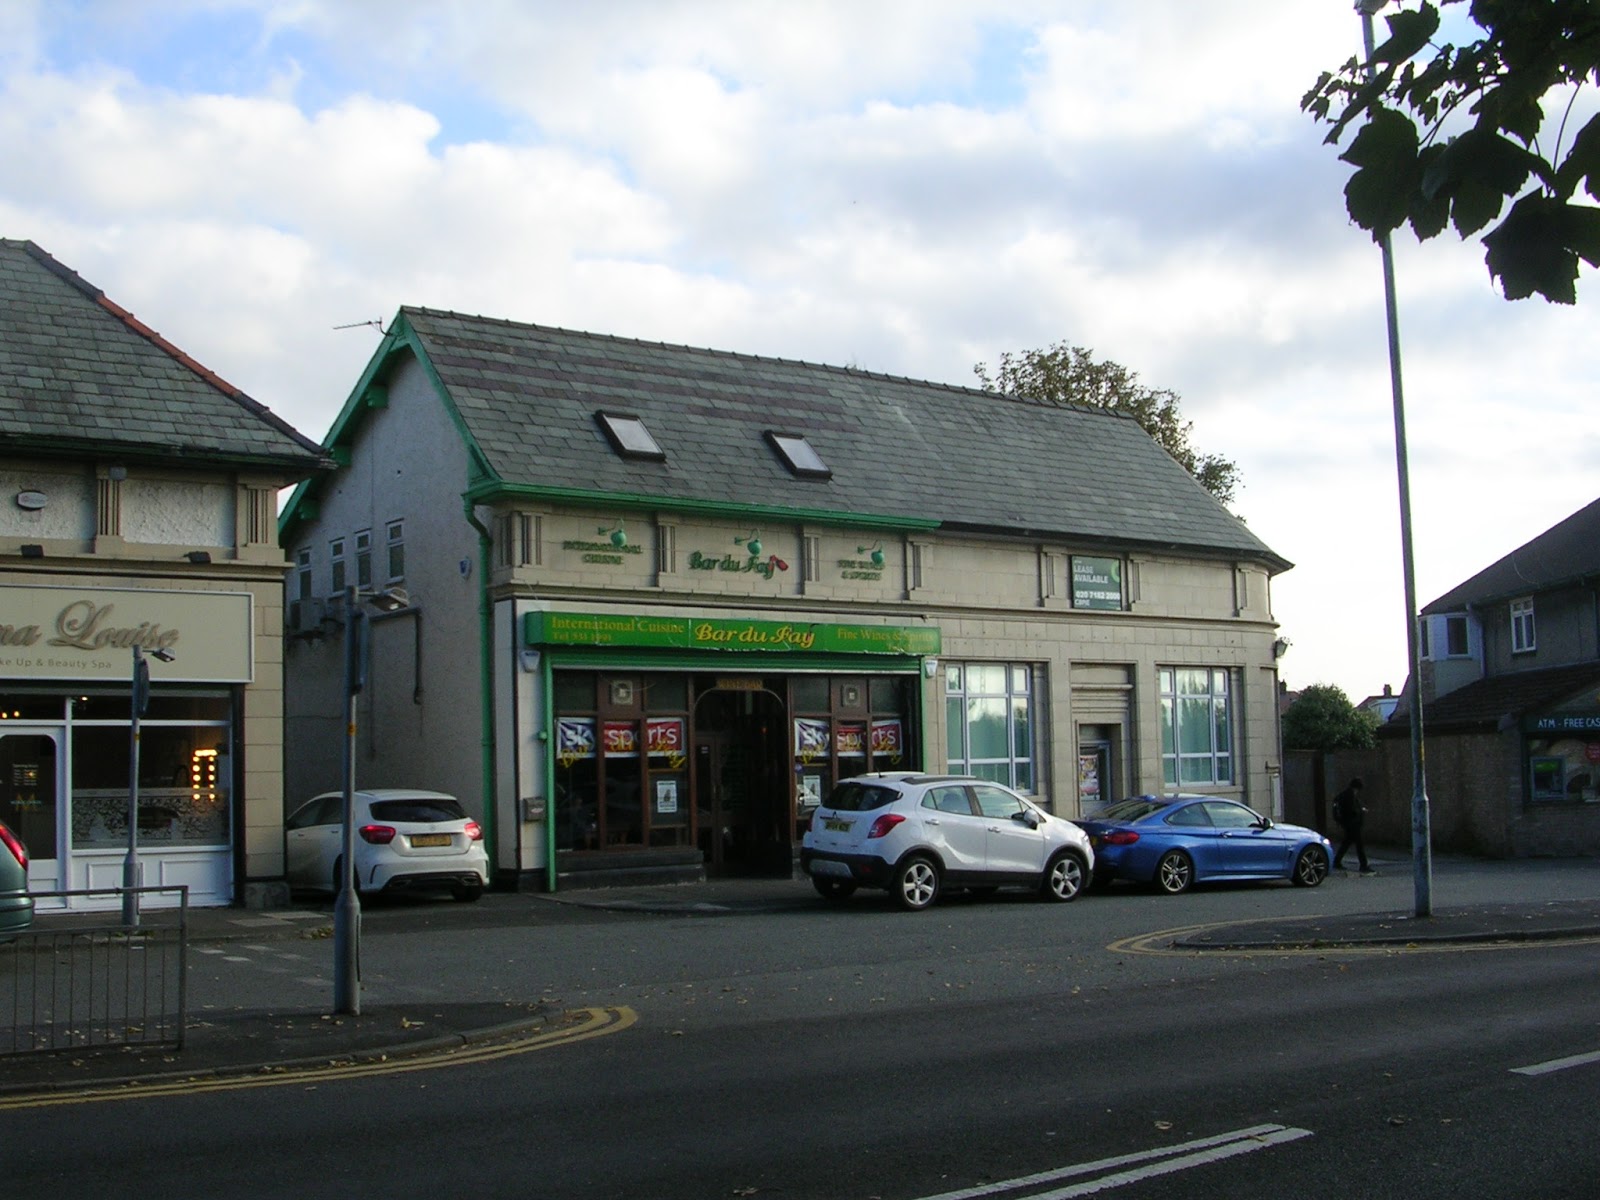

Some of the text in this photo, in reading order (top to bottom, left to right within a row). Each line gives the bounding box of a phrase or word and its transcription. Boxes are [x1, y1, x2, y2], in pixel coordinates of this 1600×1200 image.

[688, 550, 775, 580] Bar du Fay
[1073, 565, 1094, 574] LEASE
[1074, 574, 1109, 584] AVAILABLE
[48, 599, 179, 650] Louise
[551, 616, 684, 634] International Cuisine
[694, 622, 815, 649] Bar du Fay
[837, 627, 857, 640] Fine
[16, 657, 32, 667] Up
[36, 658, 44, 666] &
[48, 658, 87, 669] Beauty
[92, 660, 112, 669] Spa
[1538, 719, 1556, 729] ATM
[1563, 718, 1585, 728] FREE
